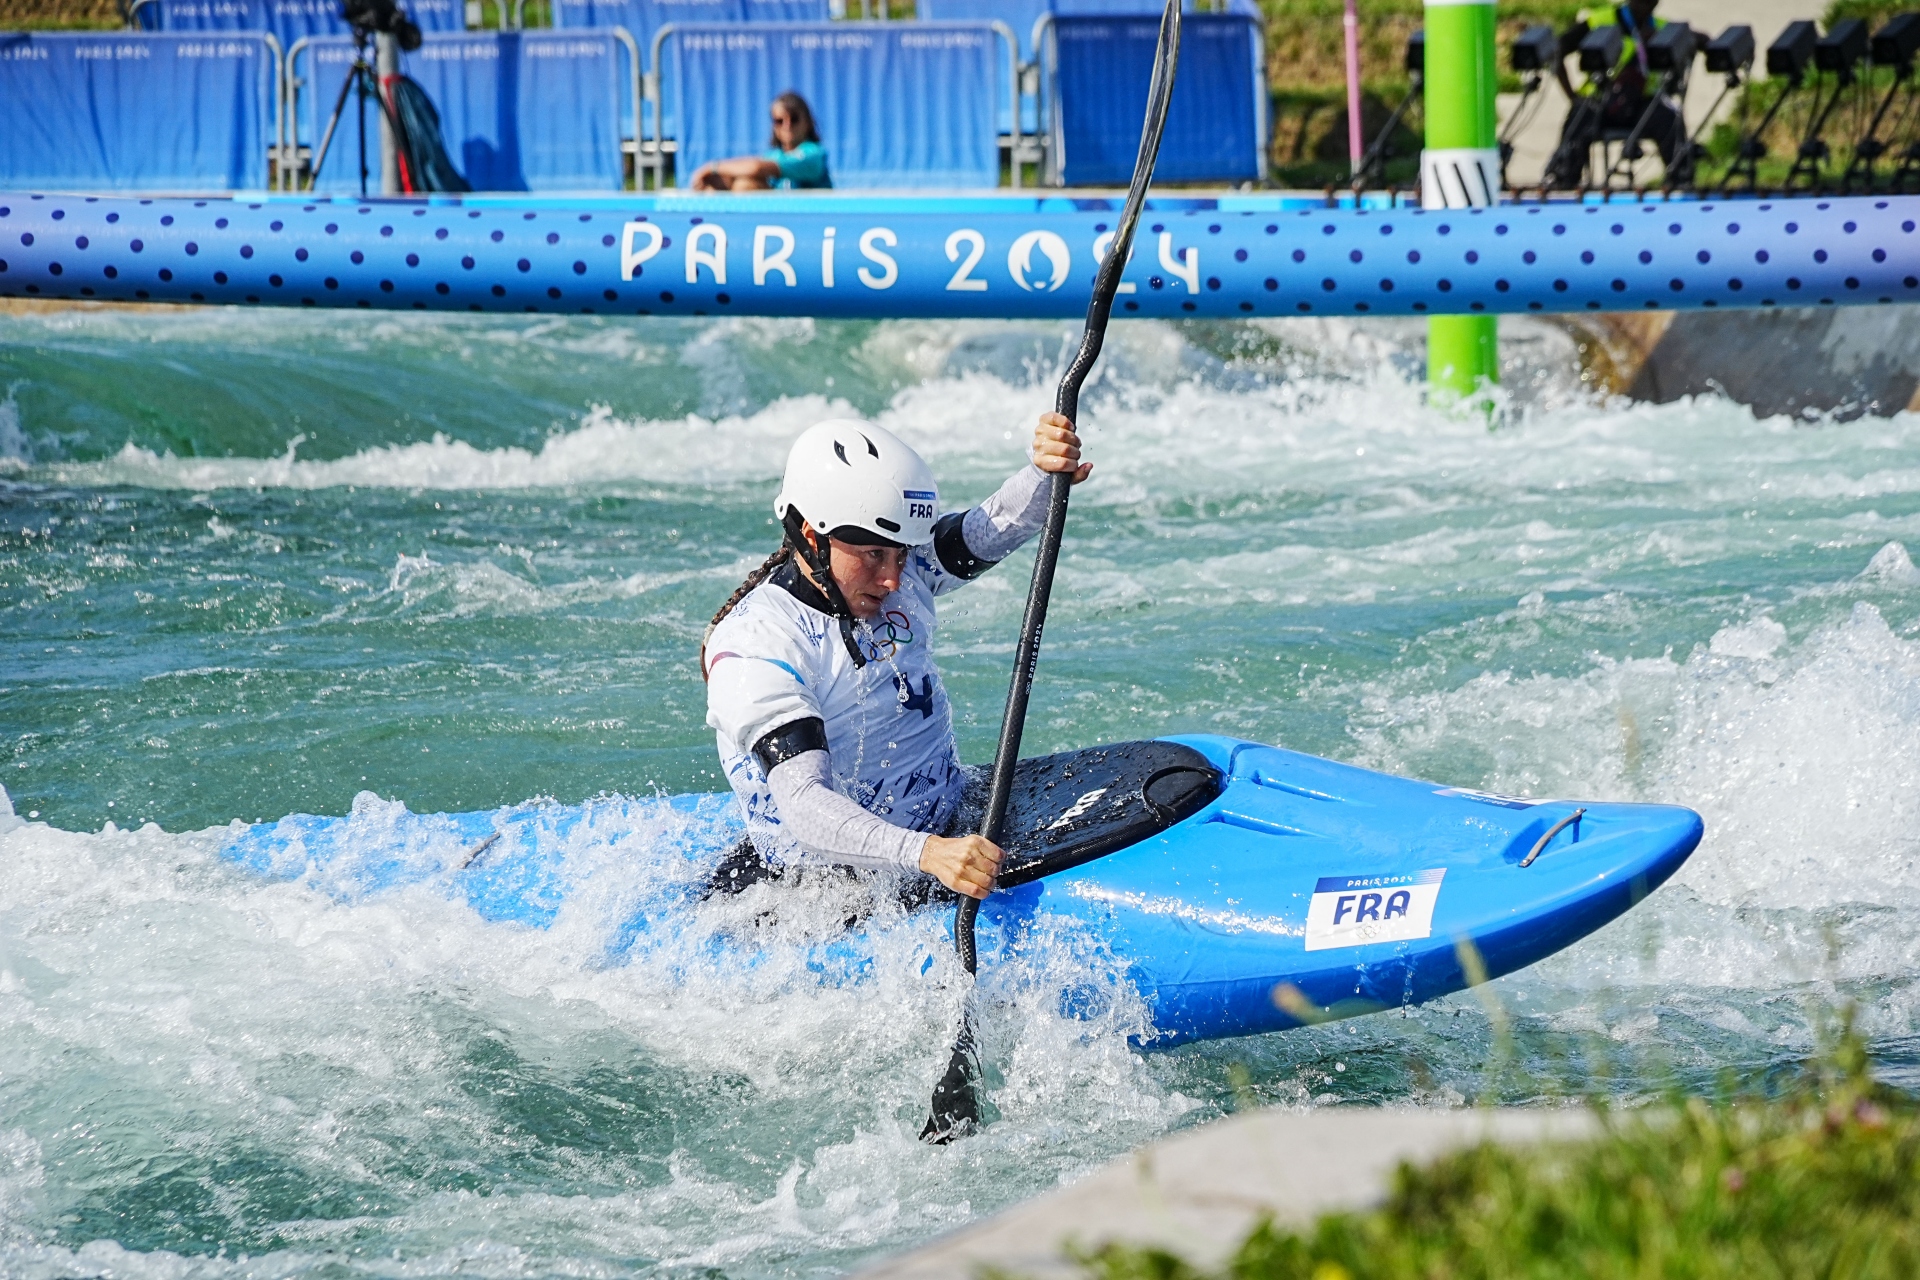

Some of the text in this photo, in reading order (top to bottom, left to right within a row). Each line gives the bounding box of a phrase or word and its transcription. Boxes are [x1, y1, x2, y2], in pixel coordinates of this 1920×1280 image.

[909, 503, 933, 519] FRA
[1028, 623, 1043, 679] PARIS 2024
[893, 672, 934, 720] 4
[1347, 875, 1413, 888] PARIS 2024
[1333, 890, 1411, 925] FRA
